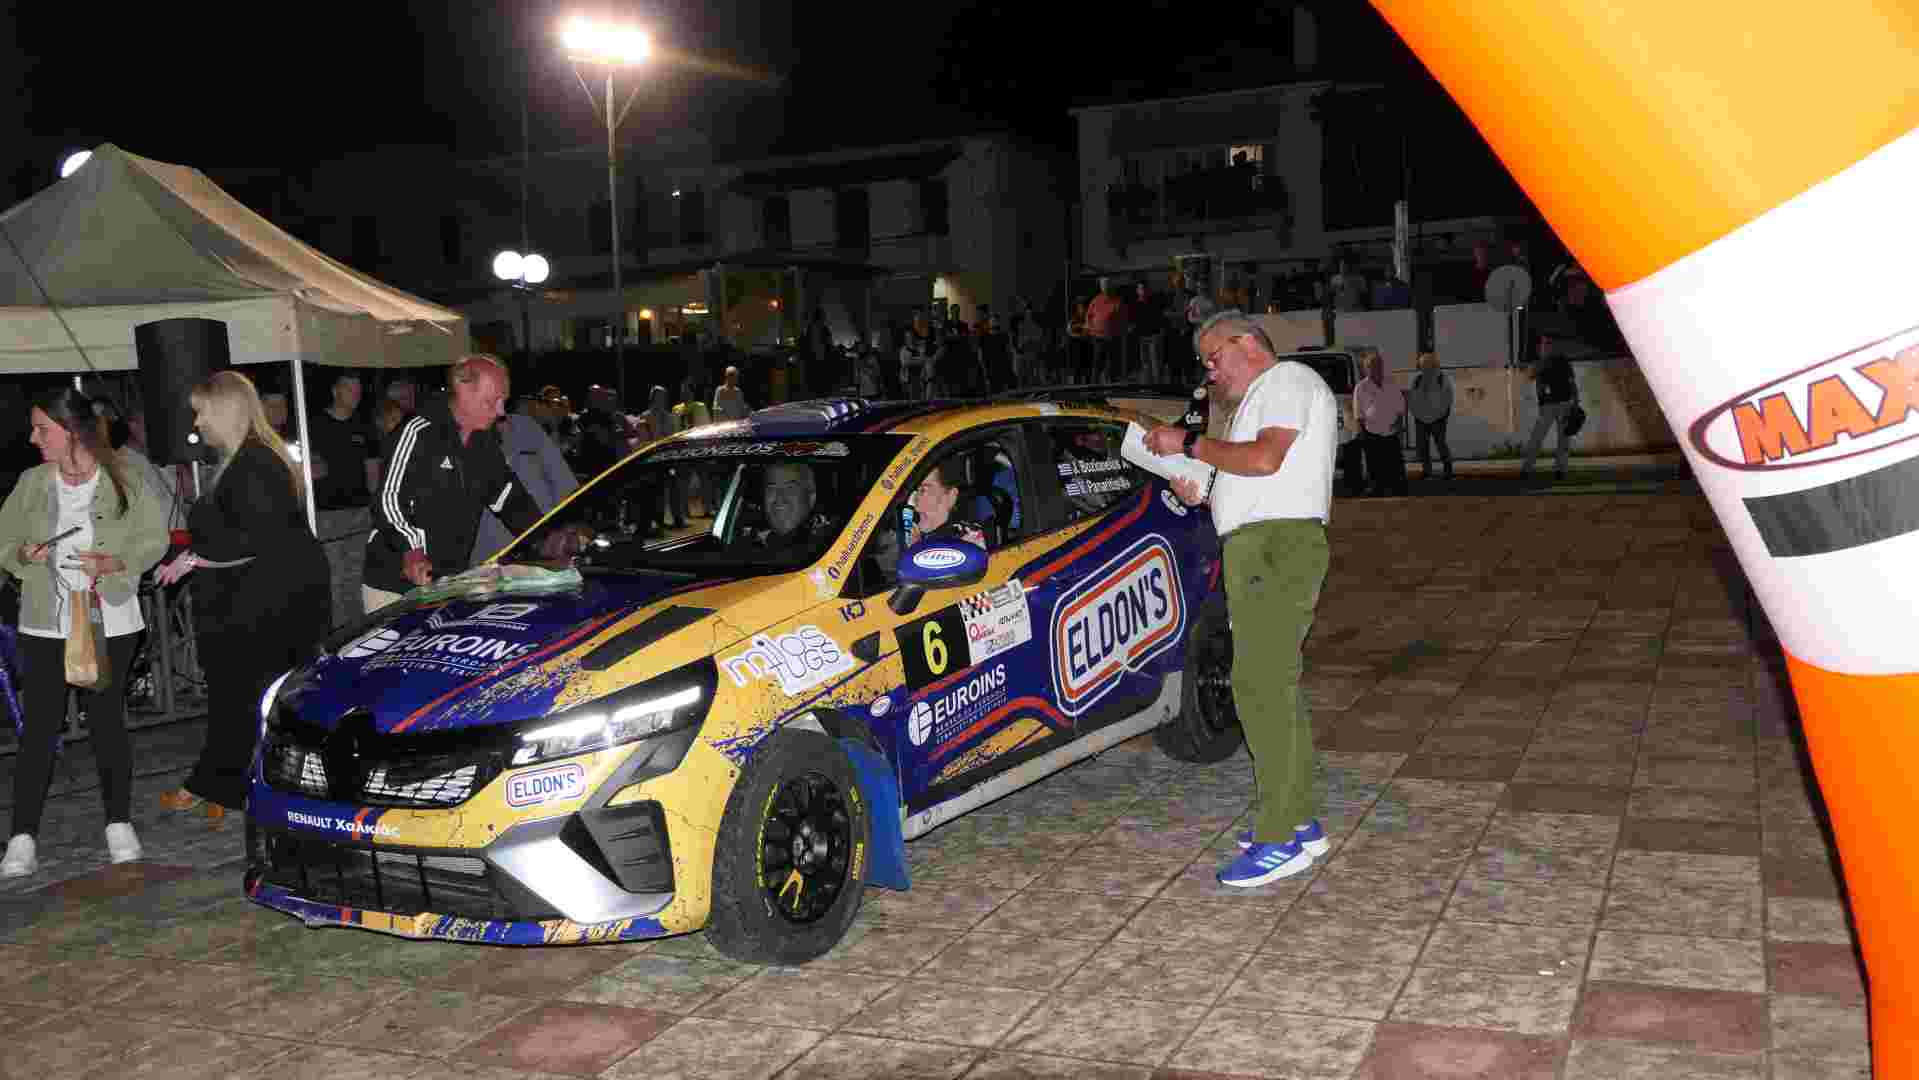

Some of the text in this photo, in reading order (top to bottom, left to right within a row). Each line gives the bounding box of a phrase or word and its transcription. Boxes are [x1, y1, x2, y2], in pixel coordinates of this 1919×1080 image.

[1068, 567, 1168, 681] ELDON'S
[384, 632, 532, 661] EUROINS
[923, 620, 948, 675] 6
[934, 663, 1006, 724] EUROINS
[514, 772, 577, 799] ELDON'S
[287, 810, 332, 829] RENAULT
